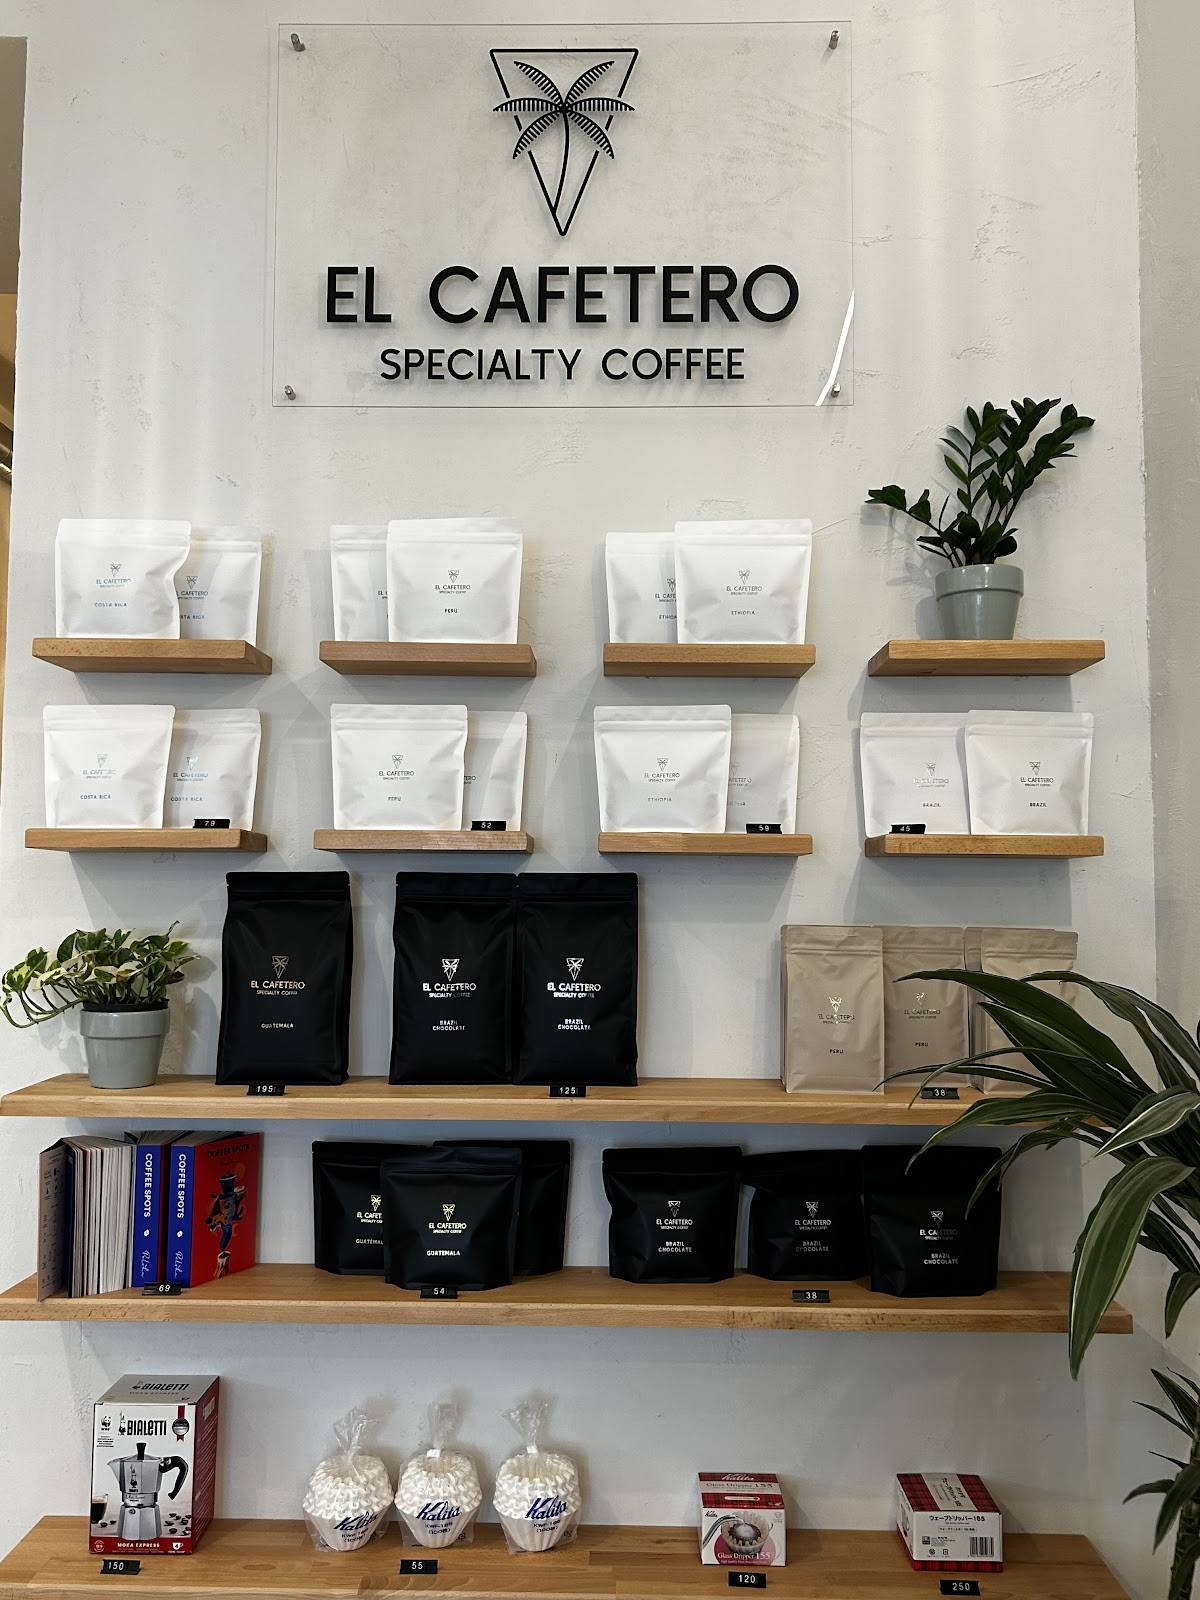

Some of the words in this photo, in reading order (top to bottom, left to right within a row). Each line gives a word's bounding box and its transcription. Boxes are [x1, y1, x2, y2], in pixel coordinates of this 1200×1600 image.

[326, 266, 392, 323] EL
[429, 264, 799, 323] CAFETERO
[380, 348, 582, 380] SPECIALTY
[602, 348, 745, 380] COFFEE
[250, 980, 259, 989] EL
[262, 980, 306, 990] CAFETERO
[422, 983, 431, 991] EL
[434, 982, 477, 992] CAFETERO
[547, 982, 556, 991] EL
[558, 982, 601, 992] CAFETERO
[257, 1085, 273, 1093] 195
[559, 1086, 576, 1094] 125
[934, 1089, 946, 1097] 38
[144, 1153, 153, 1188] COFFEE
[177, 1154, 187, 1189] COFFEE
[143, 1189, 152, 1218] SPOTS
[176, 1190, 186, 1219] SPOTS
[436, 1222, 467, 1230] CAFETERO
[663, 1218, 693, 1226] CAFETERO
[158, 1284, 171, 1292] 69
[433, 1287, 445, 1295] 54
[805, 1291, 817, 1299] 38
[141, 1383, 190, 1391] BIALETTI
[127, 1420, 167, 1436] BIALETTI
[721, 1473, 754, 1481] Kalita
[416, 1501, 461, 1521] Kalita
[525, 1495, 567, 1520] Kalita
[333, 1511, 379, 1531] Kalita
[733, 1552, 754, 1561] Dripper
[756, 1552, 771, 1560] 155
[108, 1562, 124, 1570] 150
[411, 1561, 423, 1570] 55
[738, 1574, 756, 1583] 120
[952, 1582, 971, 1591] 250
